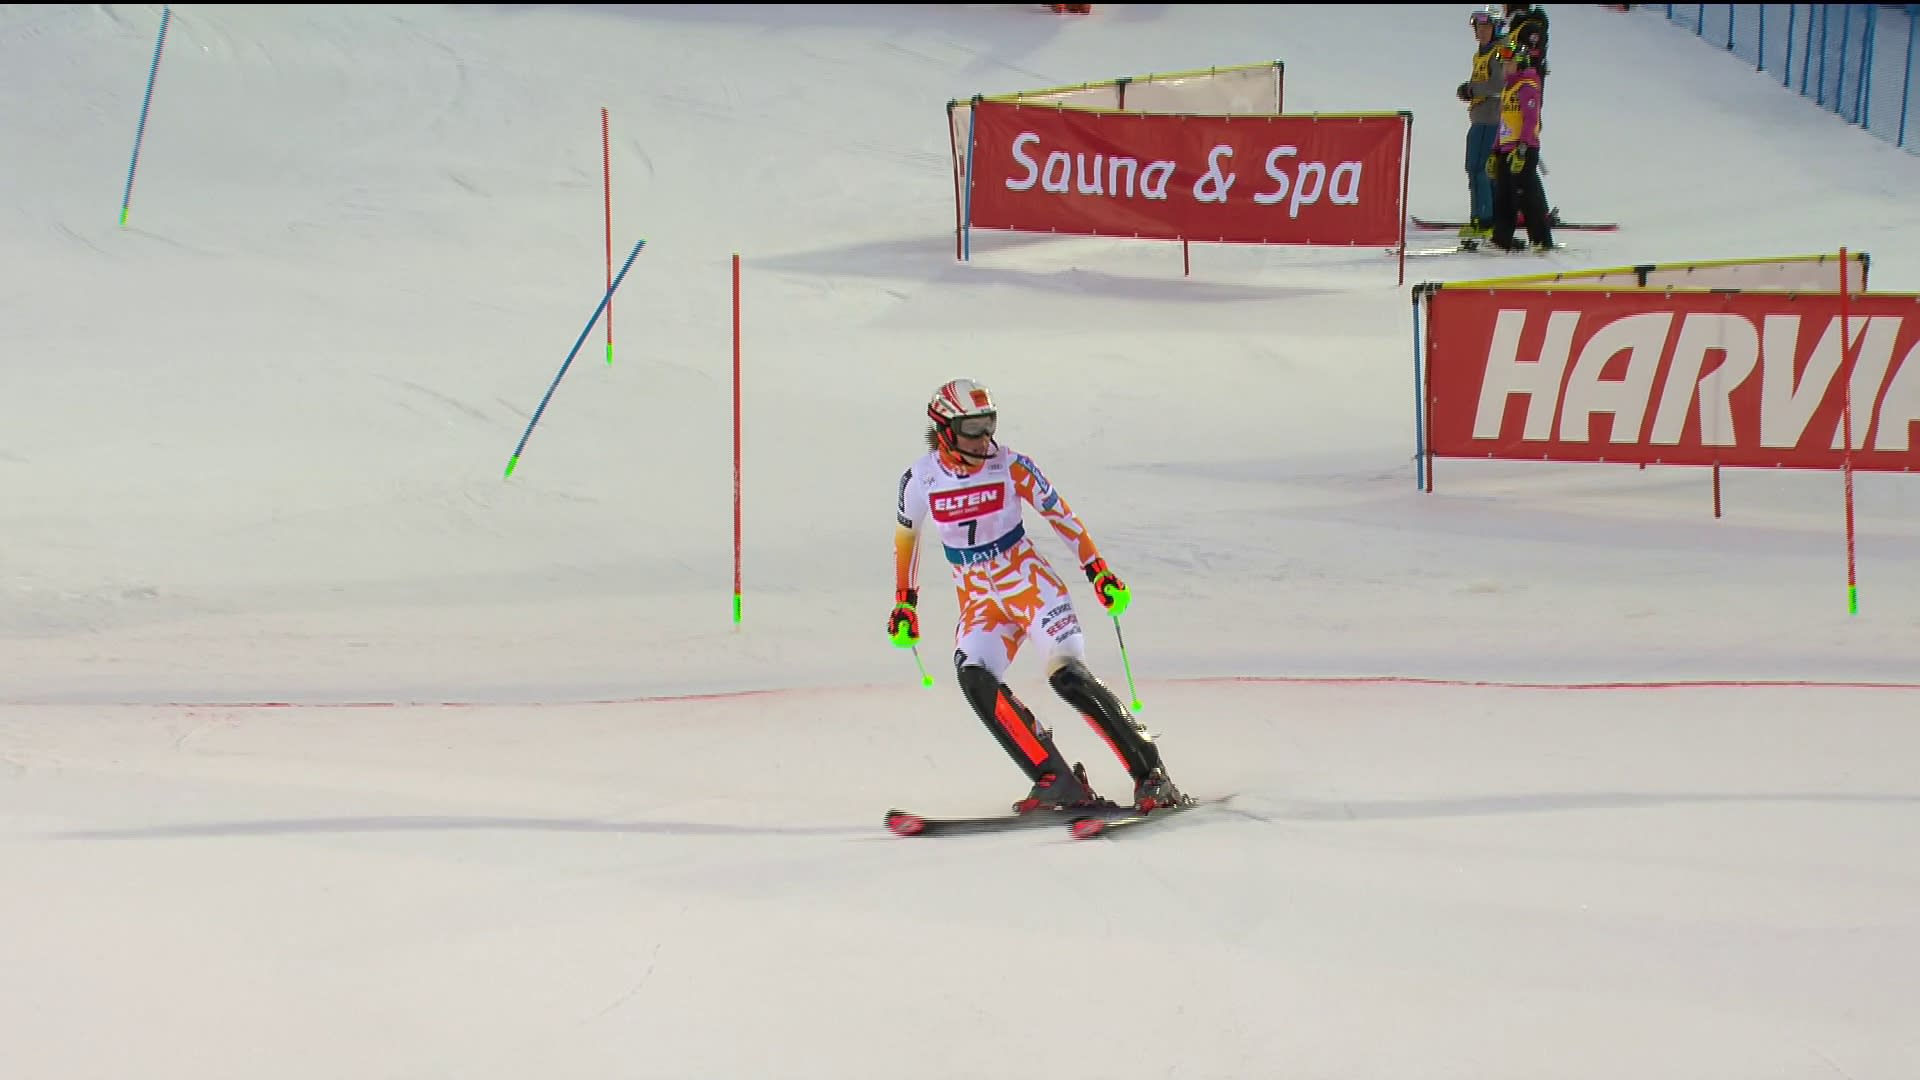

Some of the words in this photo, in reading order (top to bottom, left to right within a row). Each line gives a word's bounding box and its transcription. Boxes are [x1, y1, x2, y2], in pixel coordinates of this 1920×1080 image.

[1006, 132, 1175, 200] Sauna
[1193, 144, 1236, 204] &
[1254, 145, 1363, 218] Spa
[934, 490, 998, 511] ELTEN
[958, 519, 977, 546] 7
[960, 542, 1001, 568] Levi
